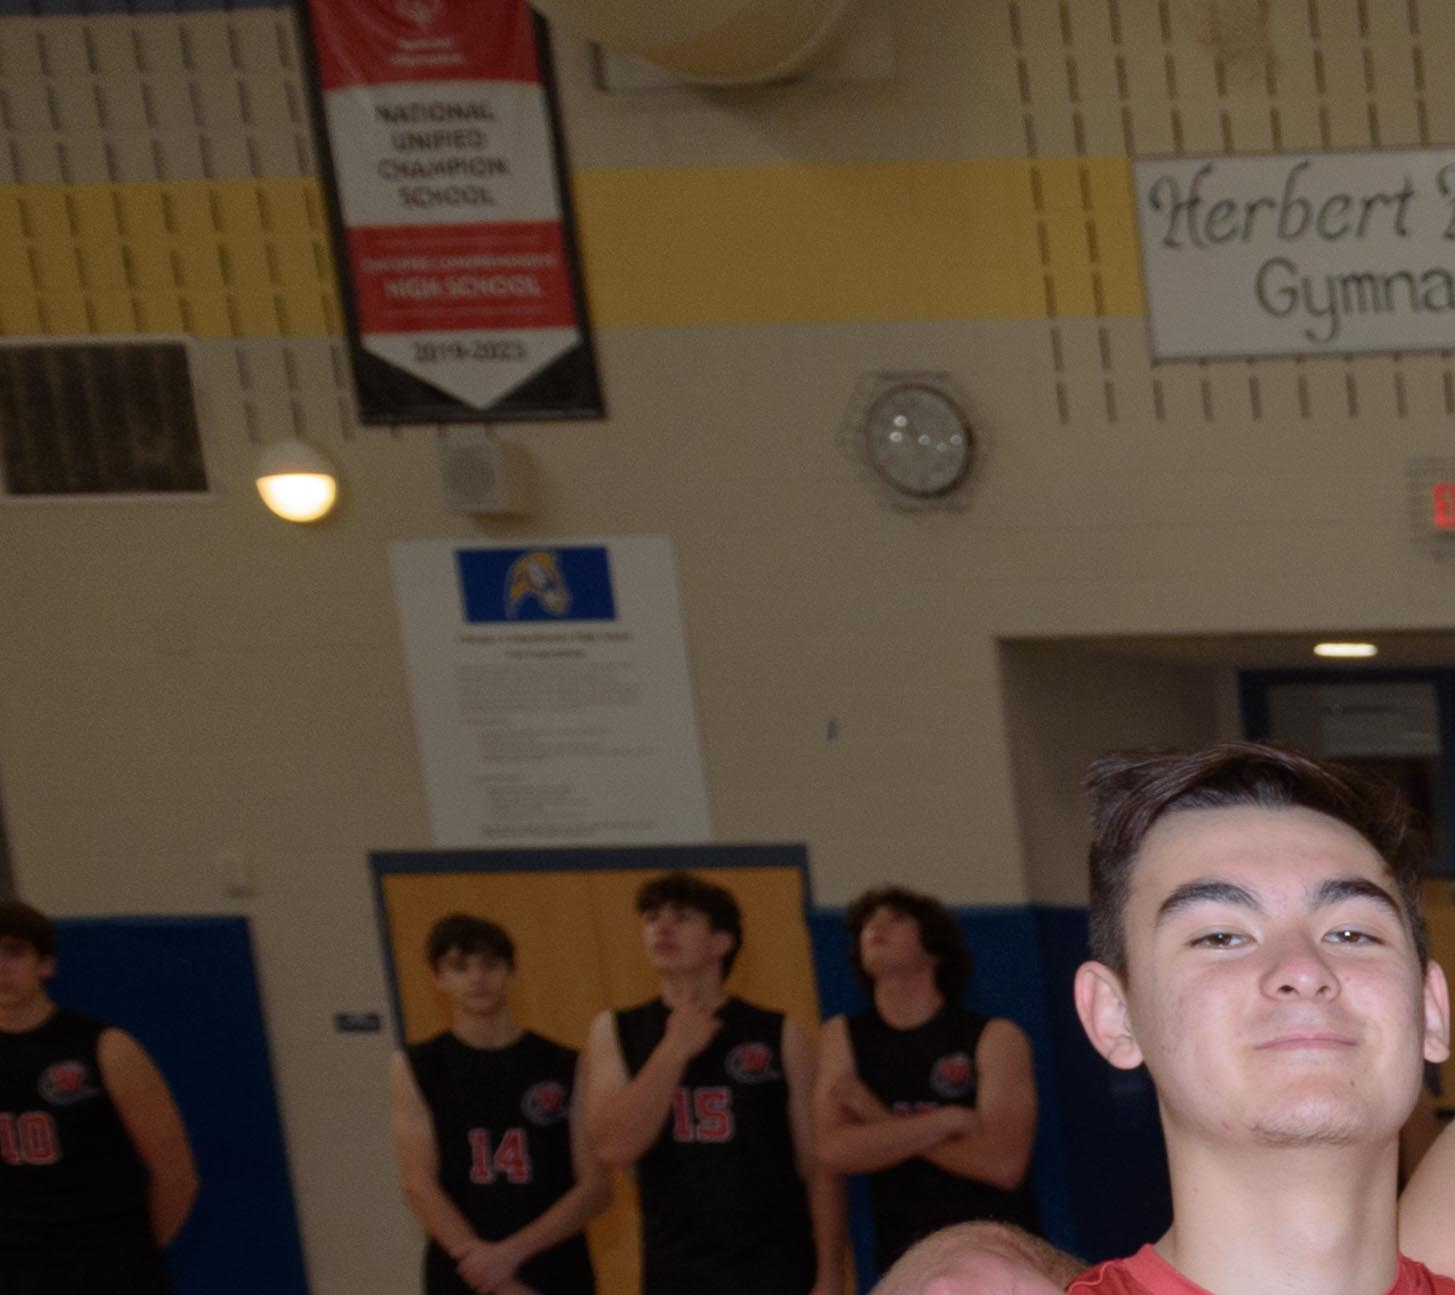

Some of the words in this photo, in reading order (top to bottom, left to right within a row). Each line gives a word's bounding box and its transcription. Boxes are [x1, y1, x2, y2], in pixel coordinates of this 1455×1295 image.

[375, 103, 495, 121] NATIONAL
[391, 128, 487, 151] UNIFIED
[376, 156, 511, 181] CHAMPION
[399, 184, 496, 208] SCHOOL
[1149, 162, 1416, 250] Herbert
[673, 1086, 736, 1143] 15
[0, 1110, 62, 1166] 10
[467, 1127, 532, 1185] 14
